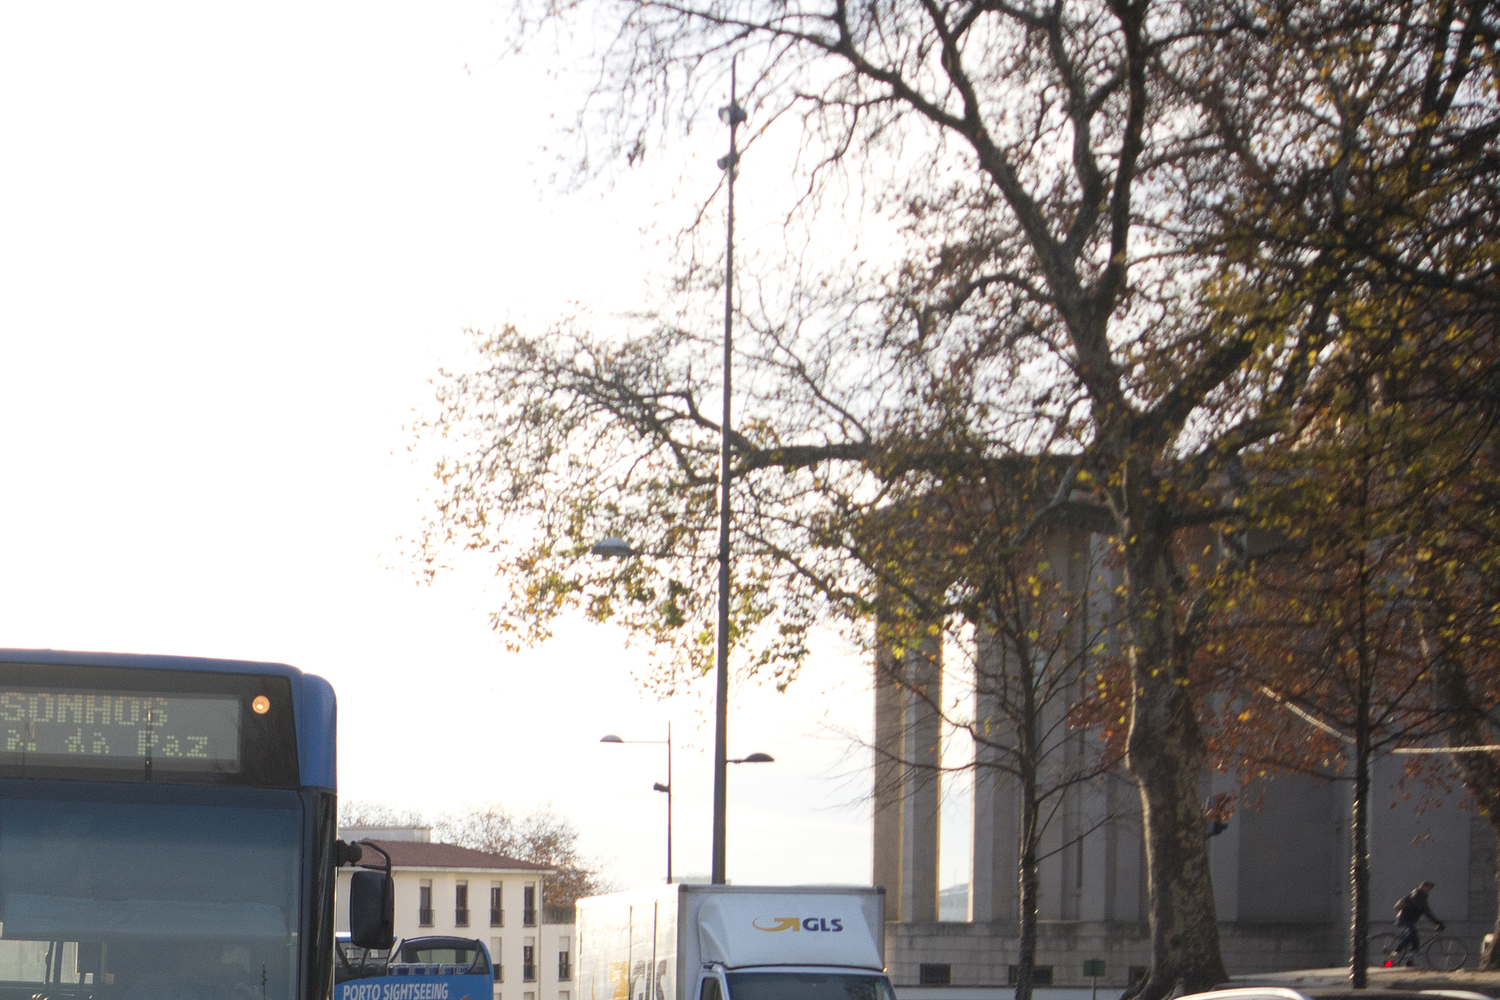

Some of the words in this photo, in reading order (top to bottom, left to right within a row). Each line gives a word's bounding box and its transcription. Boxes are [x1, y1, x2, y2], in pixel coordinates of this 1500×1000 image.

[0, 691, 168, 726] SONHOS
[137, 729, 208, 758] Paz
[802, 917, 844, 932] GLS
[382, 983, 449, 1000] SIGHTSEEING
